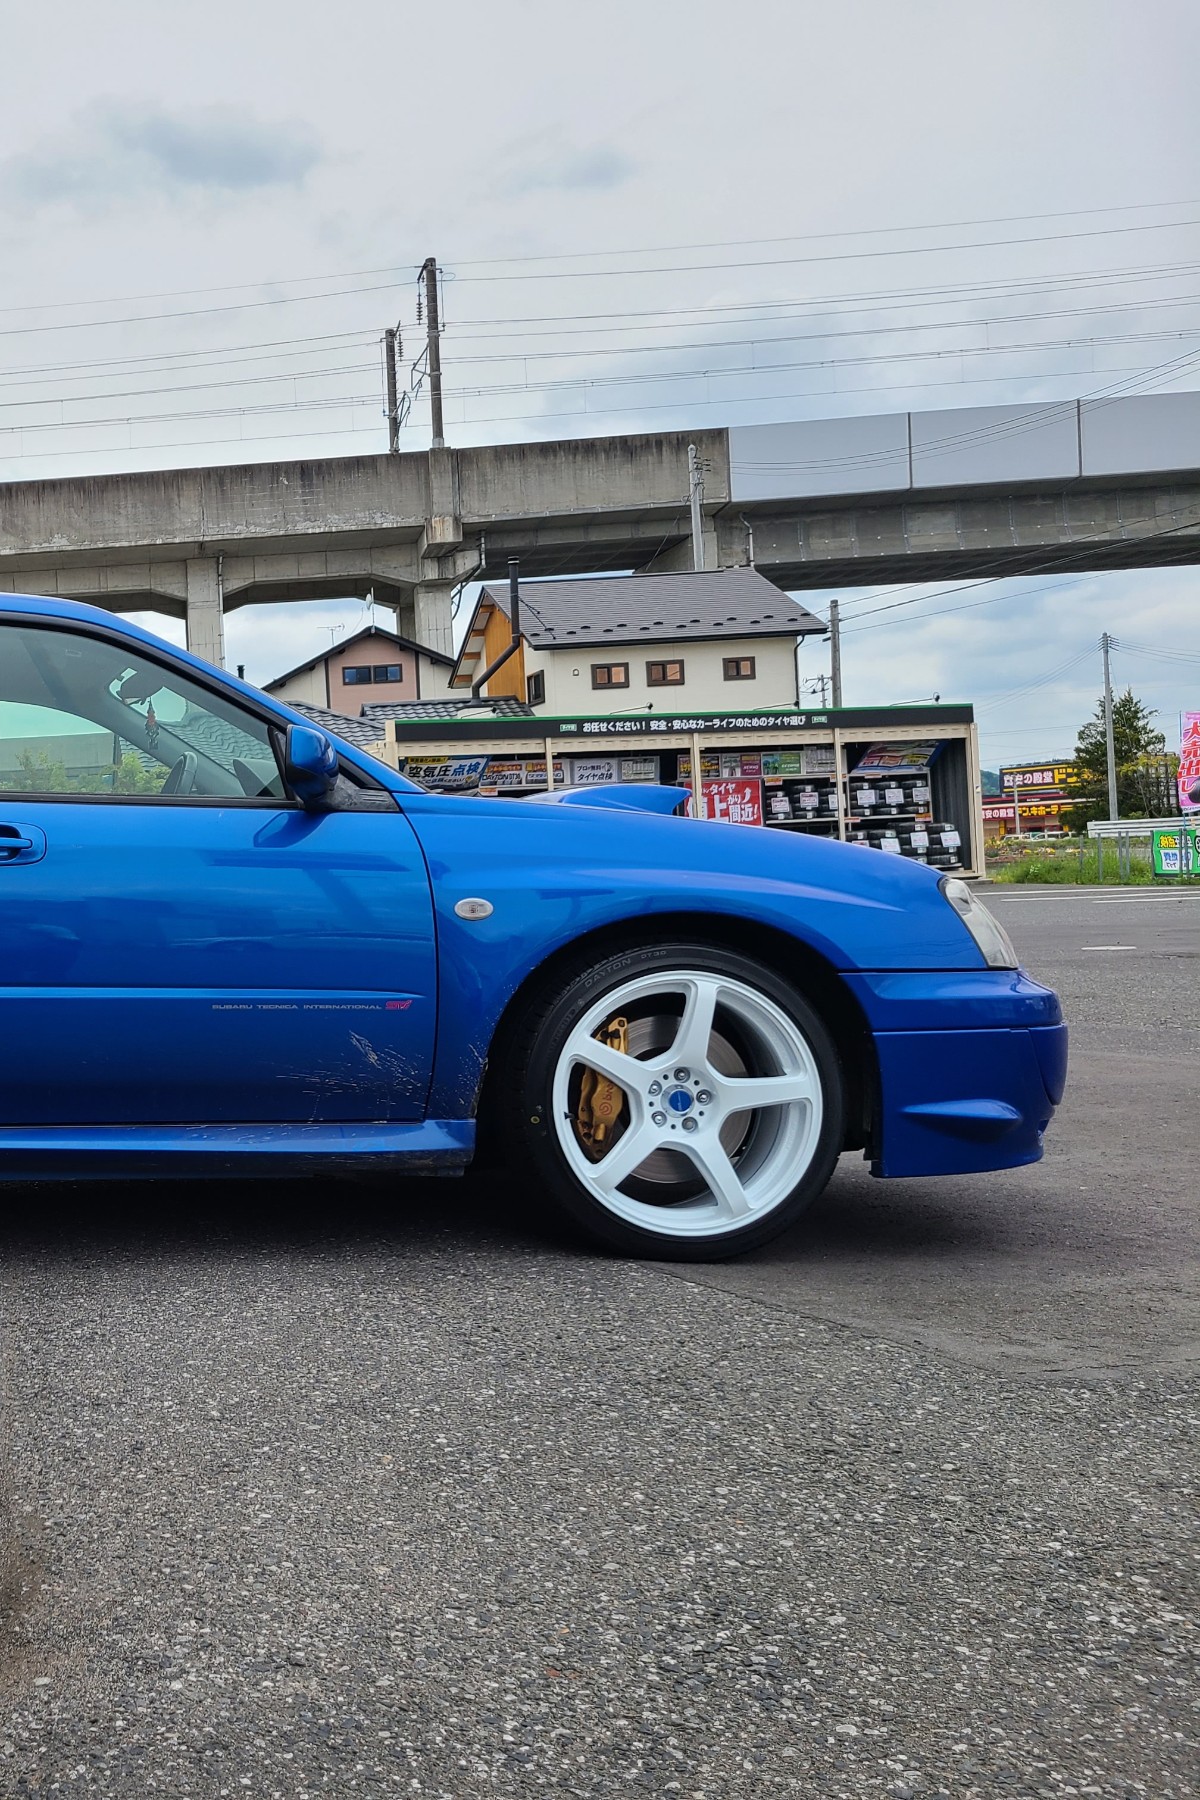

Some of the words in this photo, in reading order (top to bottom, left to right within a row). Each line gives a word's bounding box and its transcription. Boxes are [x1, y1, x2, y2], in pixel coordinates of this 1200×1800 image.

[408, 761, 481, 778] 空気圧点検
[584, 958, 632, 988] DAYTON
